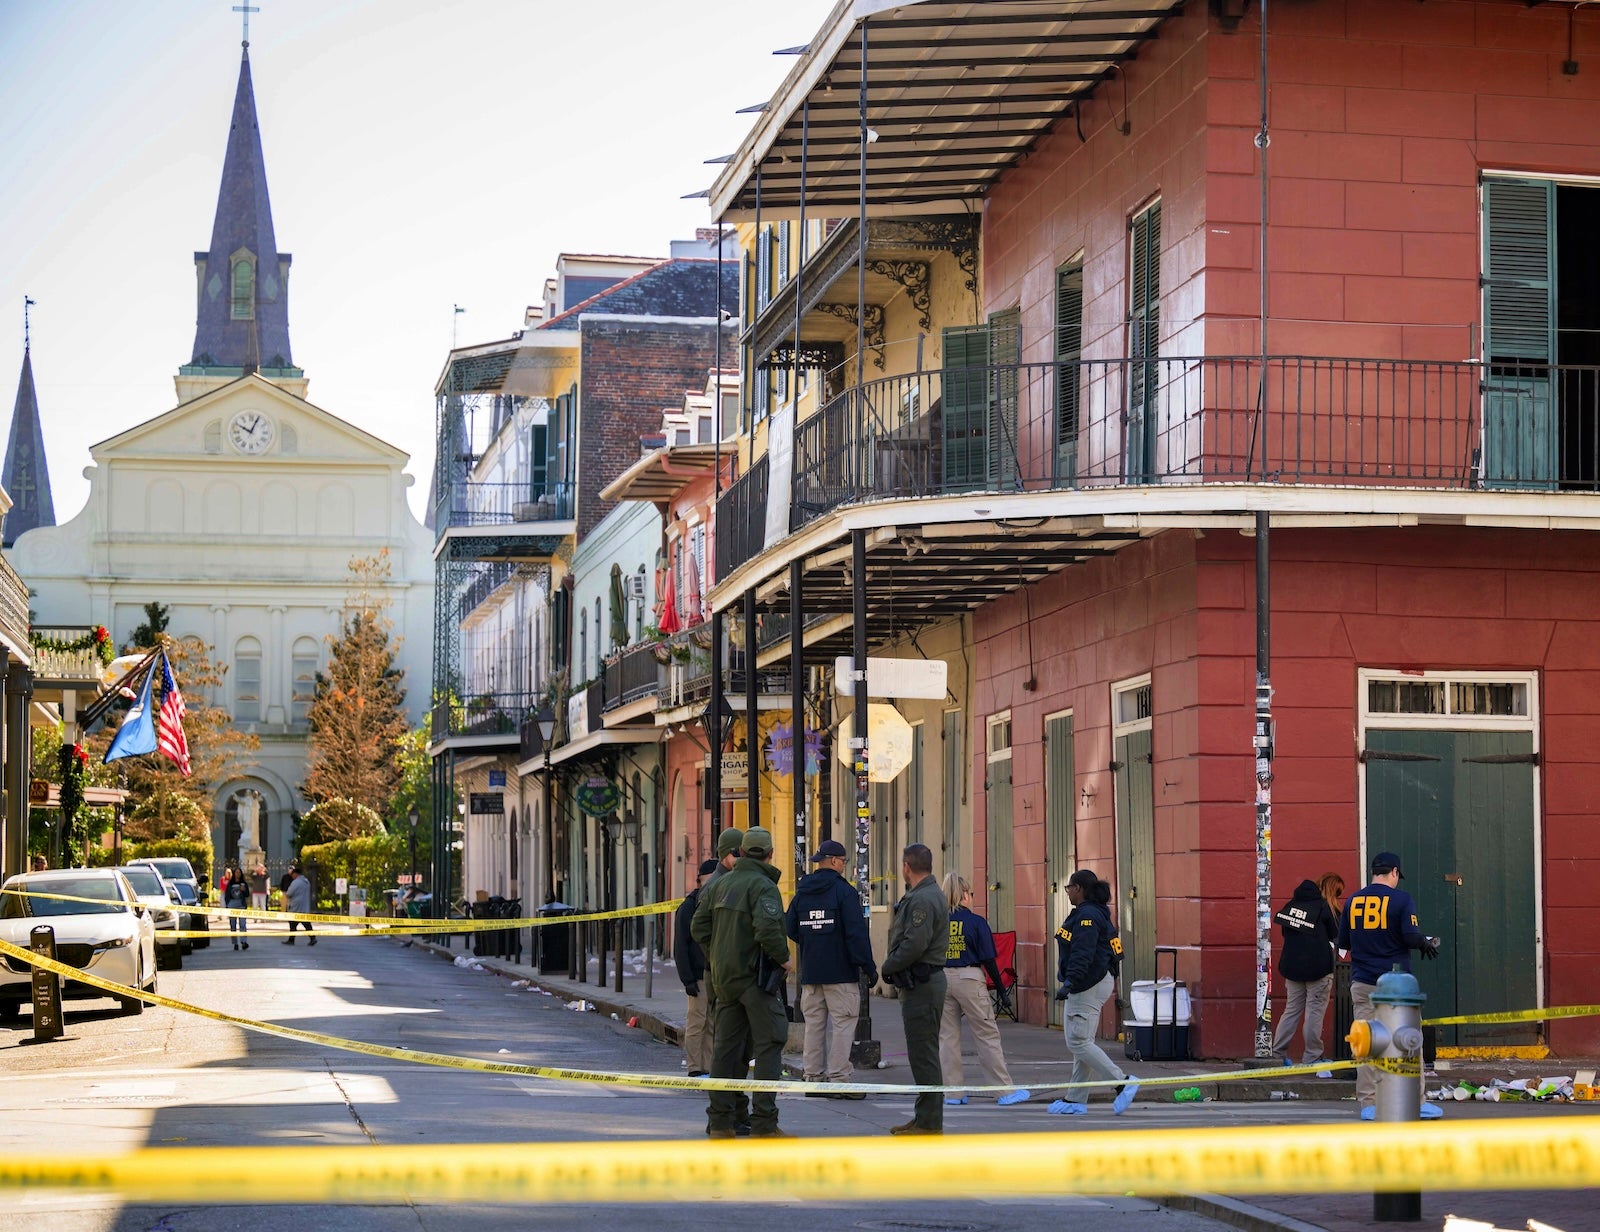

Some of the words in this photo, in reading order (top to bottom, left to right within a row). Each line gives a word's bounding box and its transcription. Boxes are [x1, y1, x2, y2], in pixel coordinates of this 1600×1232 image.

[810, 910, 824, 919] FBI
[1290, 908, 1307, 920] FBI
[1350, 896, 1389, 930] FBI
[950, 921, 963, 935] BI
[1056, 927, 1073, 942] FBI
